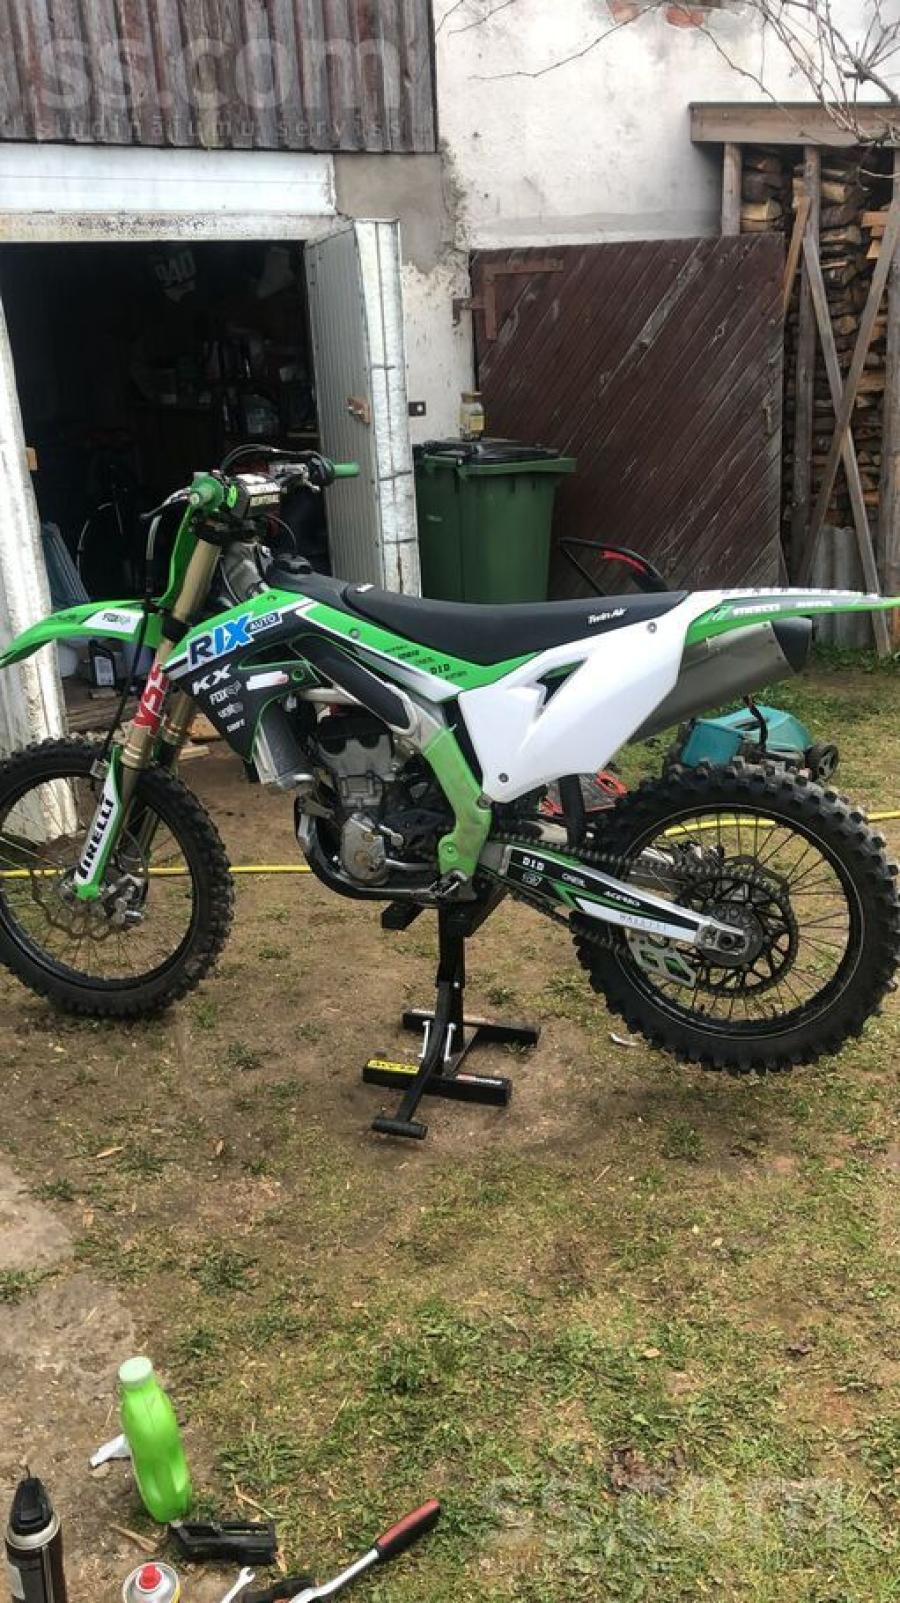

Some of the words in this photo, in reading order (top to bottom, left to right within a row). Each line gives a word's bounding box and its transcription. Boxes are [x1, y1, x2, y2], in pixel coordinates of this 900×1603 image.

[249, 613, 277, 631] AUTO
[190, 613, 252, 665] RIX
[192, 664, 231, 695] KX
